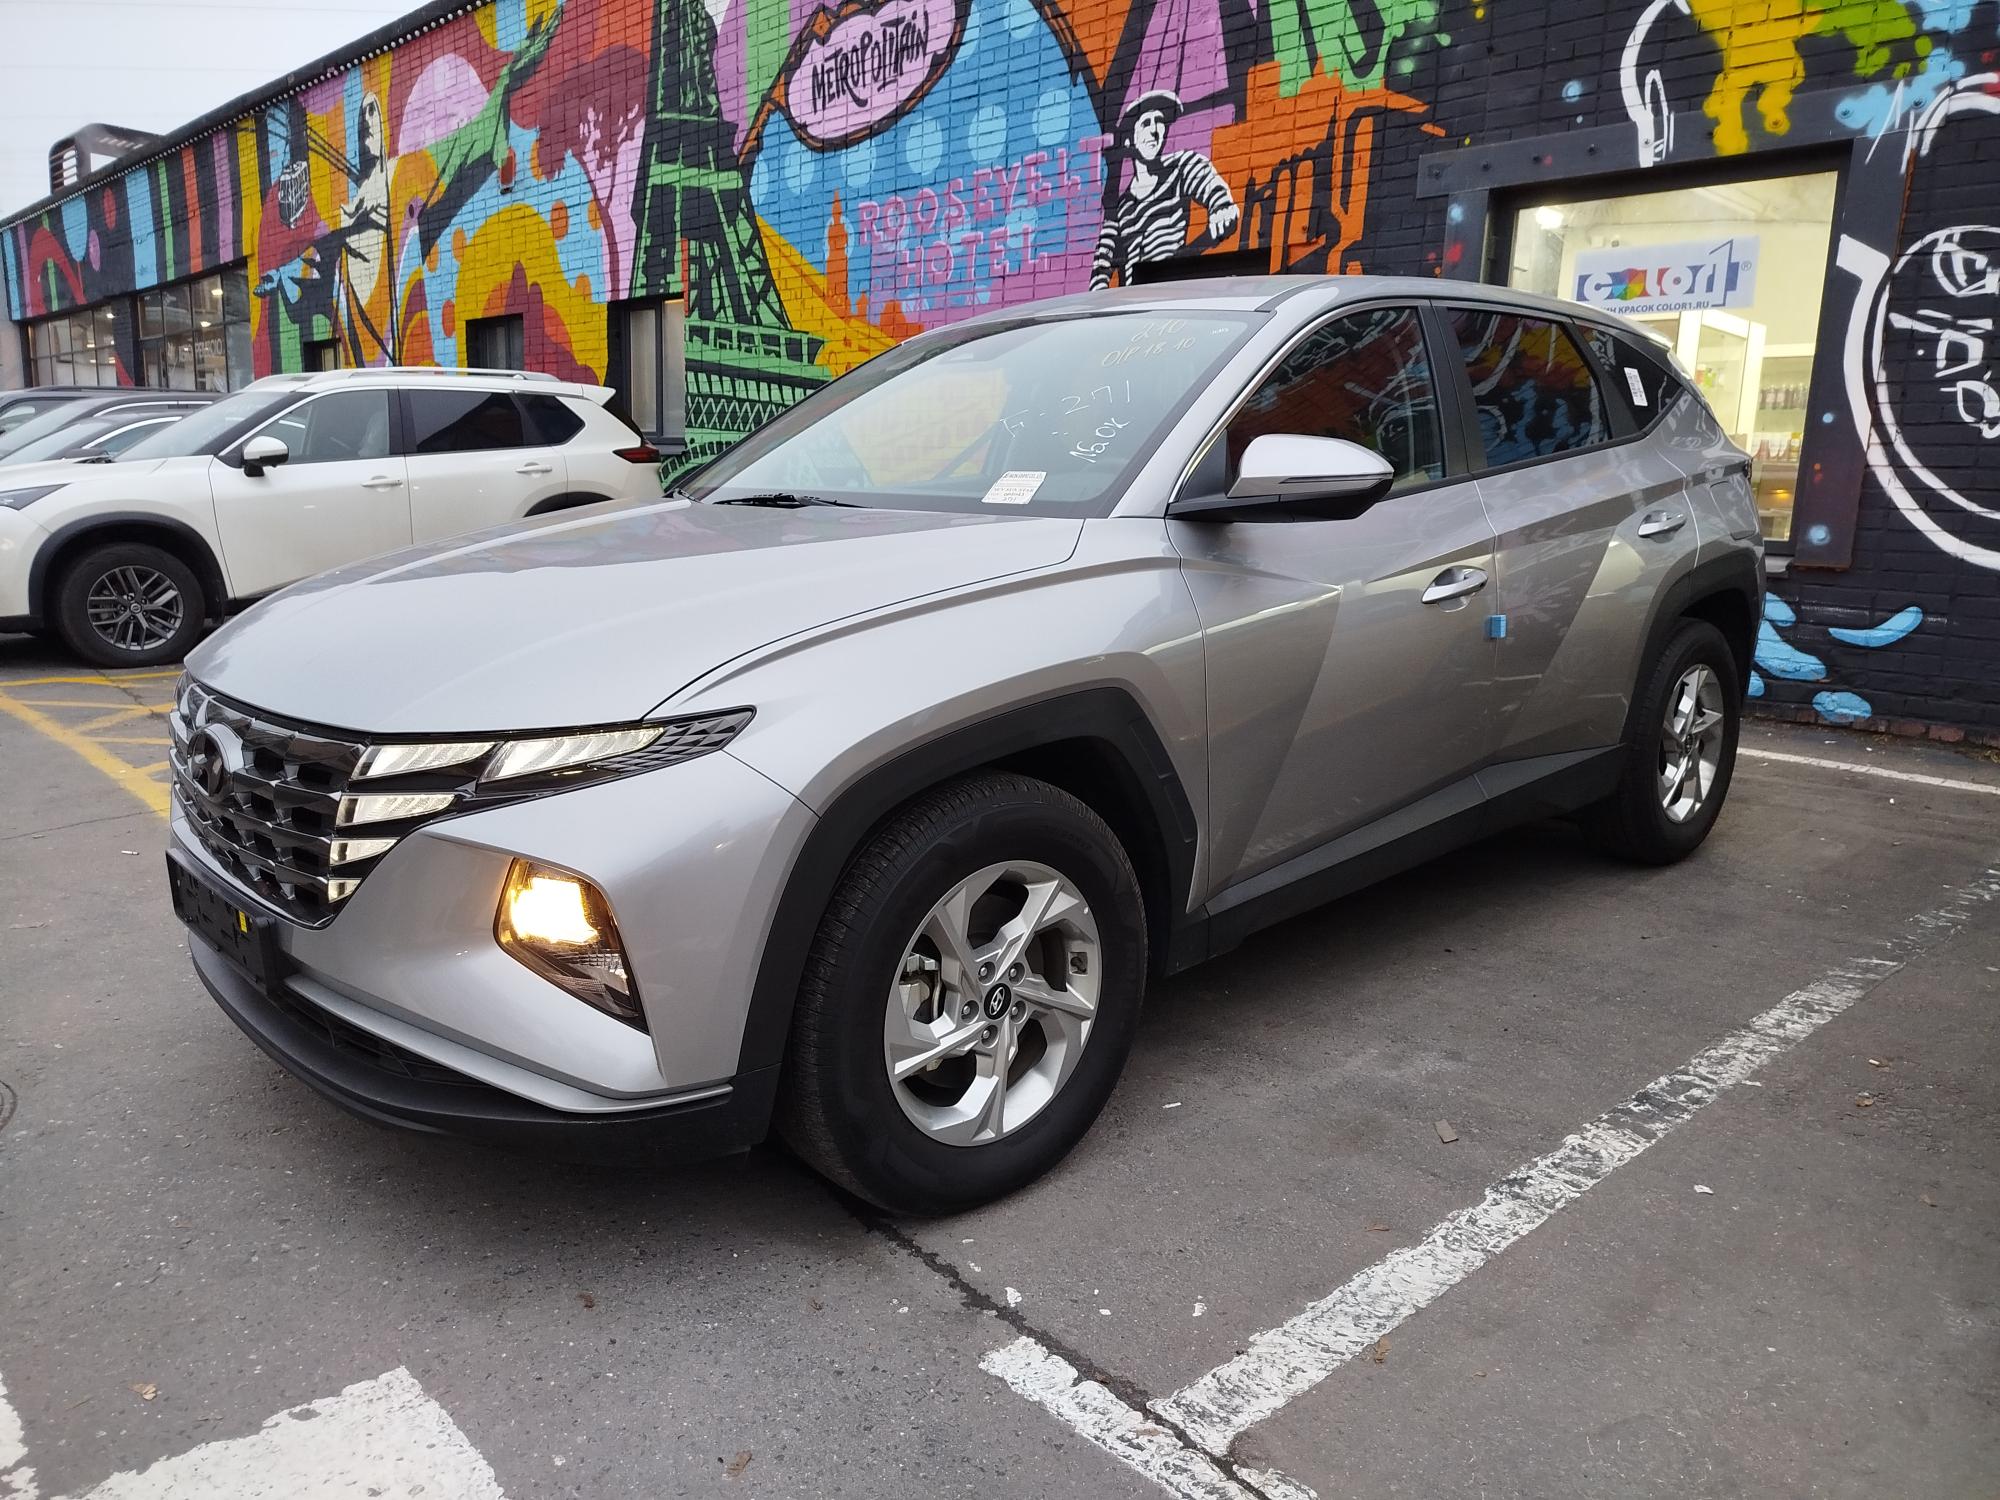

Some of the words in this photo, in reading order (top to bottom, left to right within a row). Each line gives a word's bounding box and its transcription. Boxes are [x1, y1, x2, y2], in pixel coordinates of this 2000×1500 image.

[857, 133, 1114, 246] ROOSEVELT
[896, 224, 1048, 288] HOTEL
[1618, 305, 1655, 314] КРАСОК
[1656, 300, 1710, 312] COLOR1.RU
